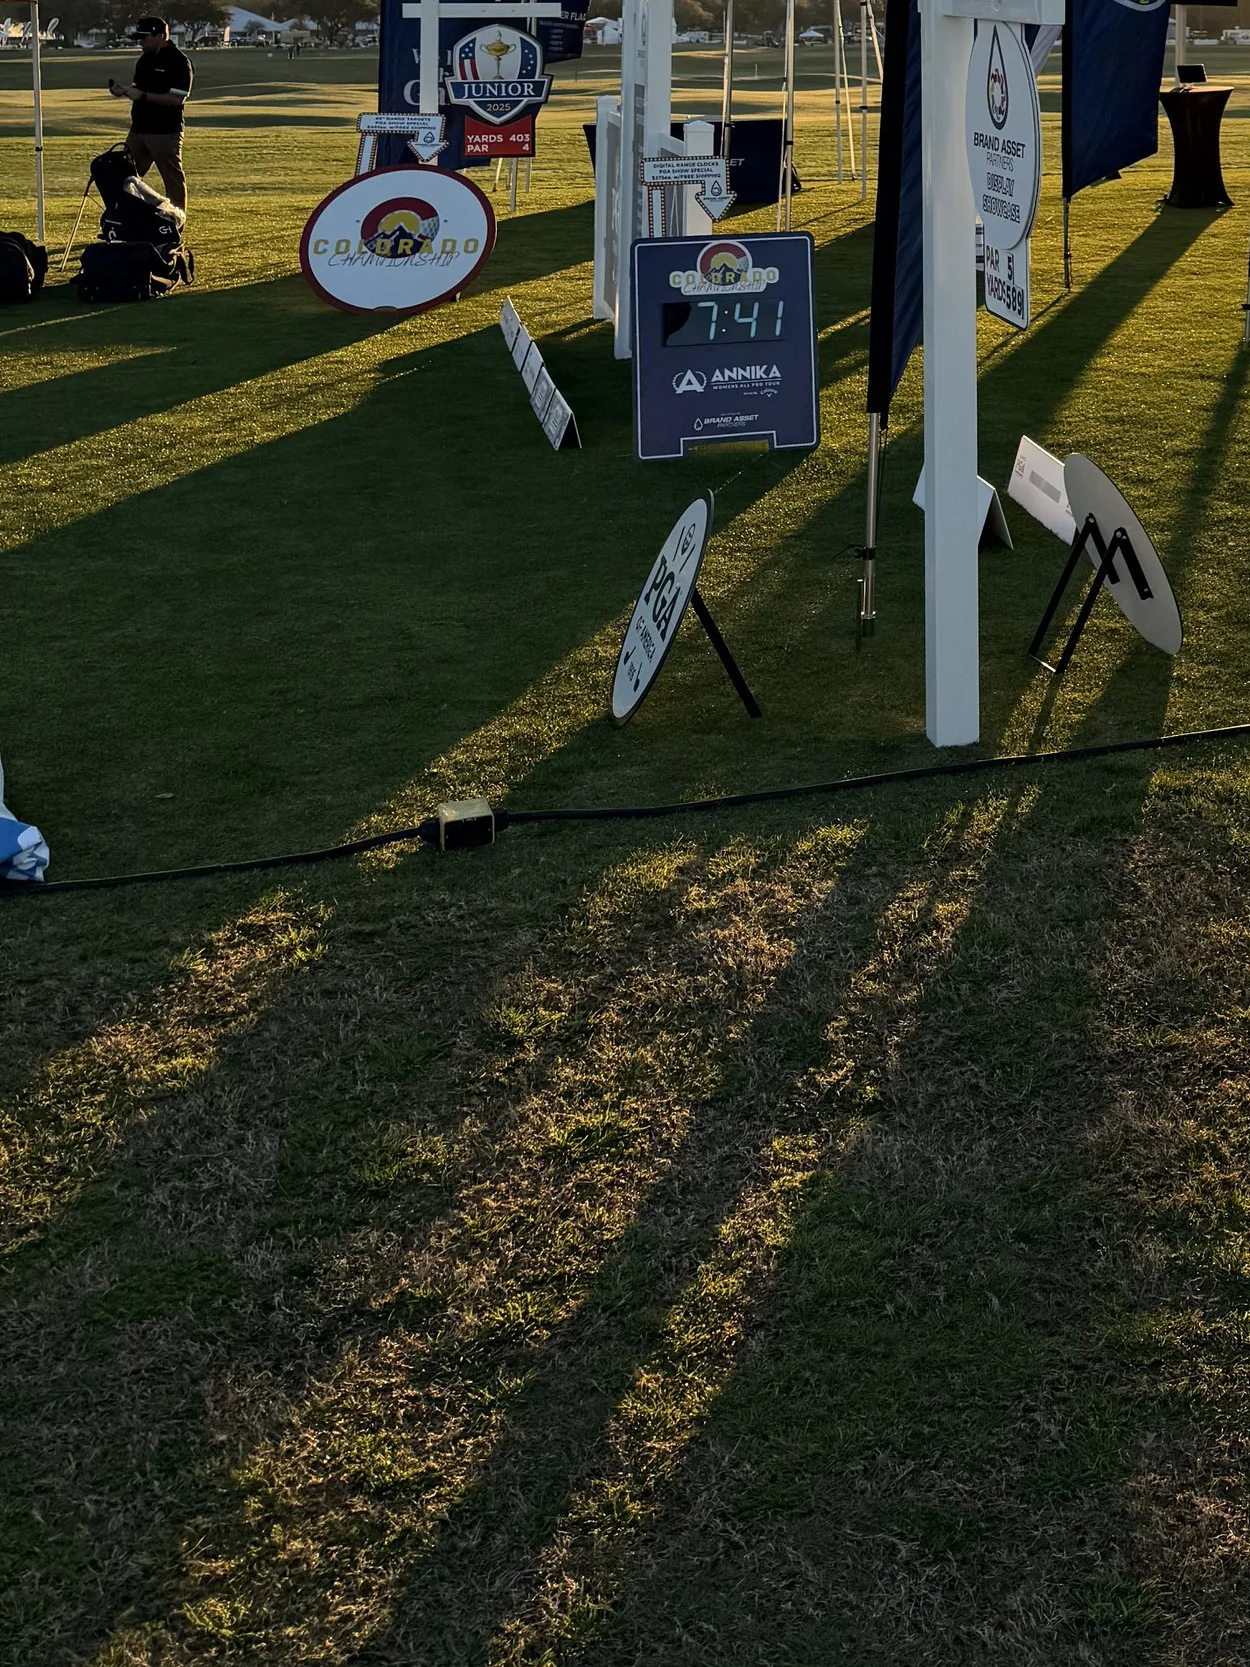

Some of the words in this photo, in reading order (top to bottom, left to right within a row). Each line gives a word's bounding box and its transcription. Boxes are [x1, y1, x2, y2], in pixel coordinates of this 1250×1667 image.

[463, 83, 536, 100] JUNIOR
[486, 103, 511, 112] 2025
[467, 134, 504, 143] YARDS
[509, 133, 530, 143] 403
[973, 131, 1000, 151] BRAND
[1001, 138, 1026, 158] ASSET
[467, 144, 489, 153] PAR
[522, 143, 530, 152] 4
[986, 152, 1014, 172] PARTNERS
[986, 172, 1015, 197] DISPLAY
[982, 194, 1020, 223] SHOWCASE
[313, 237, 480, 255] COLORADO
[986, 245, 1000, 272] PAR
[671, 269, 777, 286] COLORADO
[987, 273, 1006, 304] YARDS
[697, 300, 784, 341] 7:41
[711, 364, 781, 382] ANNIKA
[704, 416, 732, 424] BRAND
[733, 414, 759, 422] ASSET
[644, 554, 681, 642] PGA
